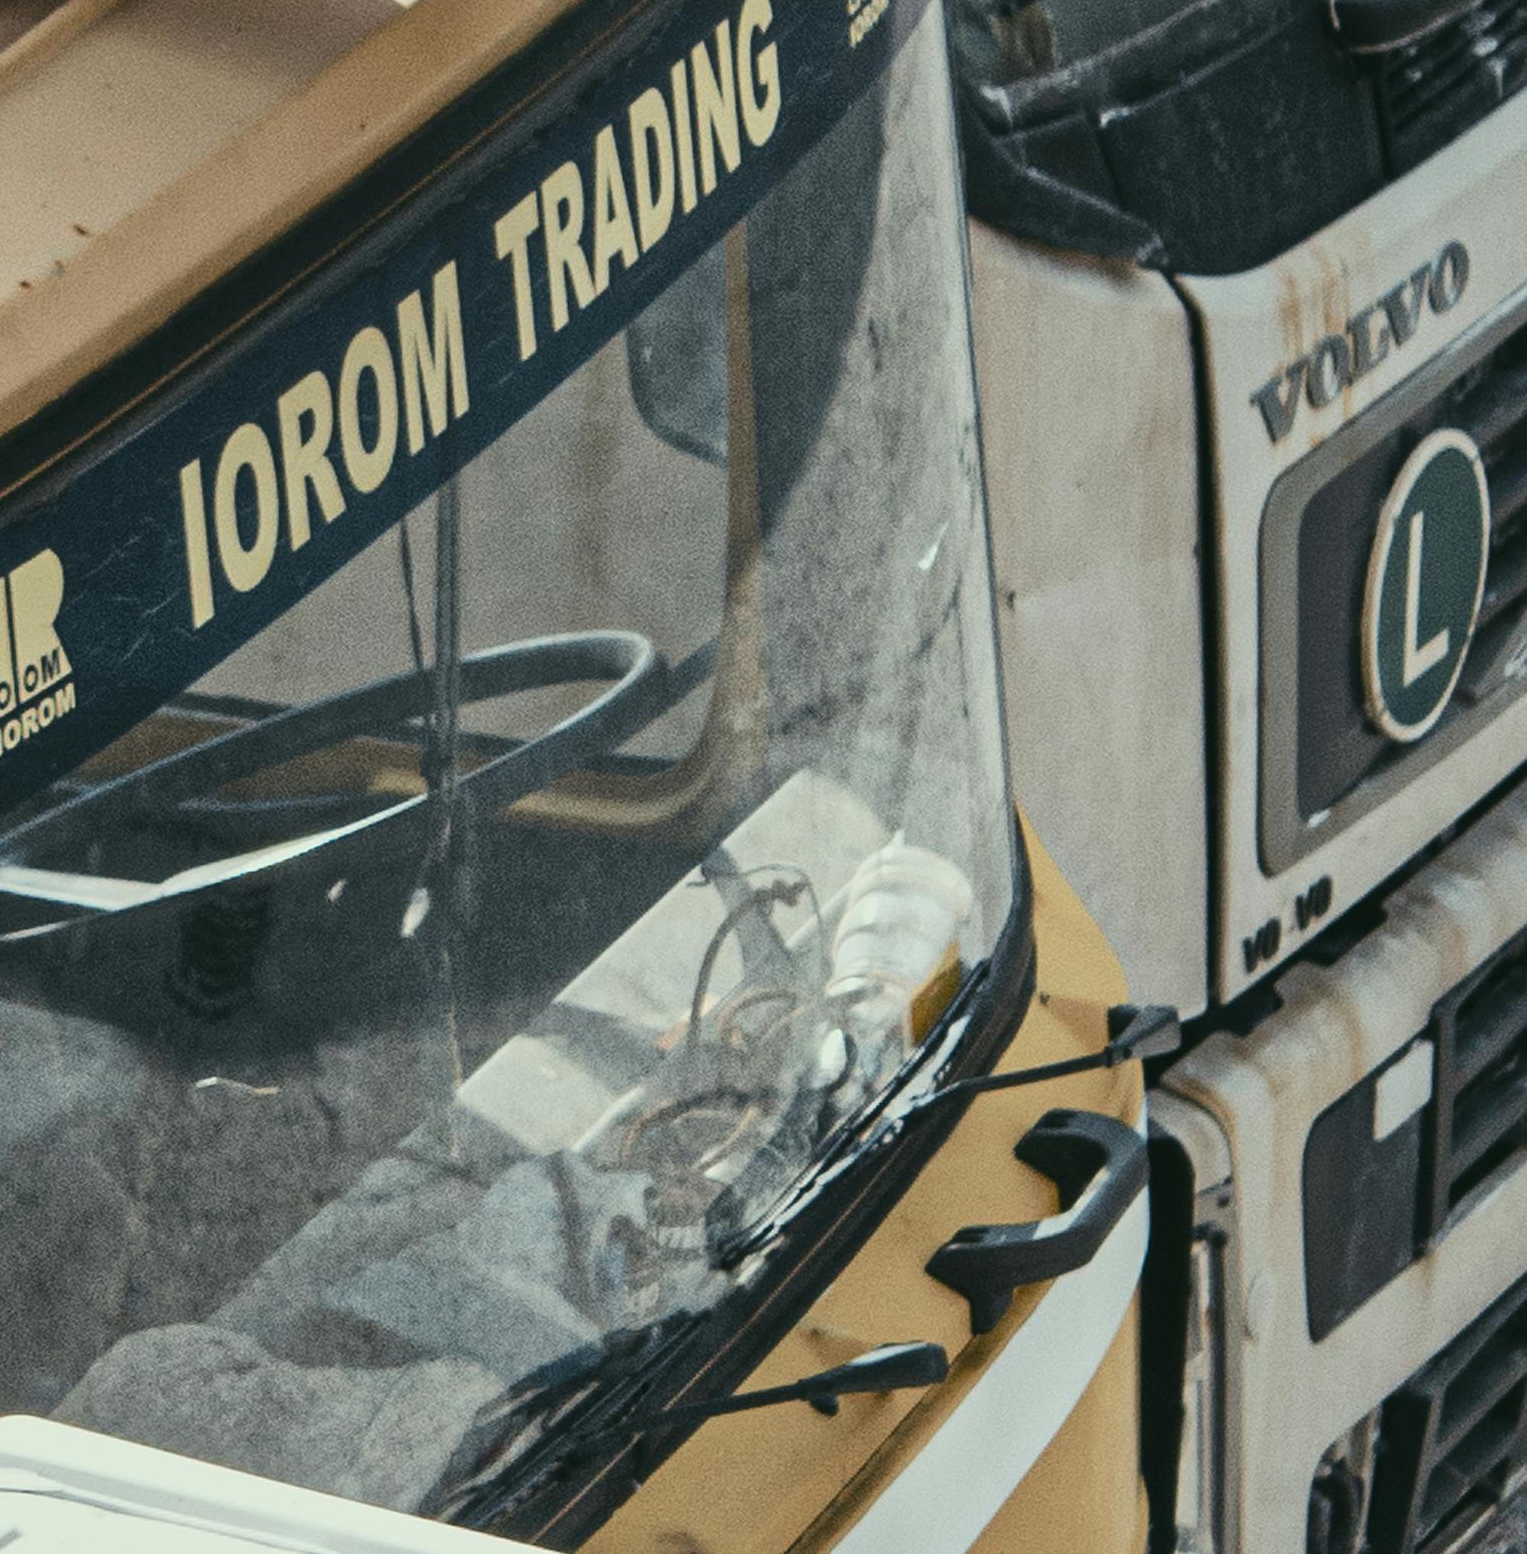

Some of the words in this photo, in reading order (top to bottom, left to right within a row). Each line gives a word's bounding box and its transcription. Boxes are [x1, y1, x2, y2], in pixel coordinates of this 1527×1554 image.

[179, 258, 470, 629] IOROM
[1250, 241, 1471, 446] VOLVO
[1403, 512, 1451, 688] L
